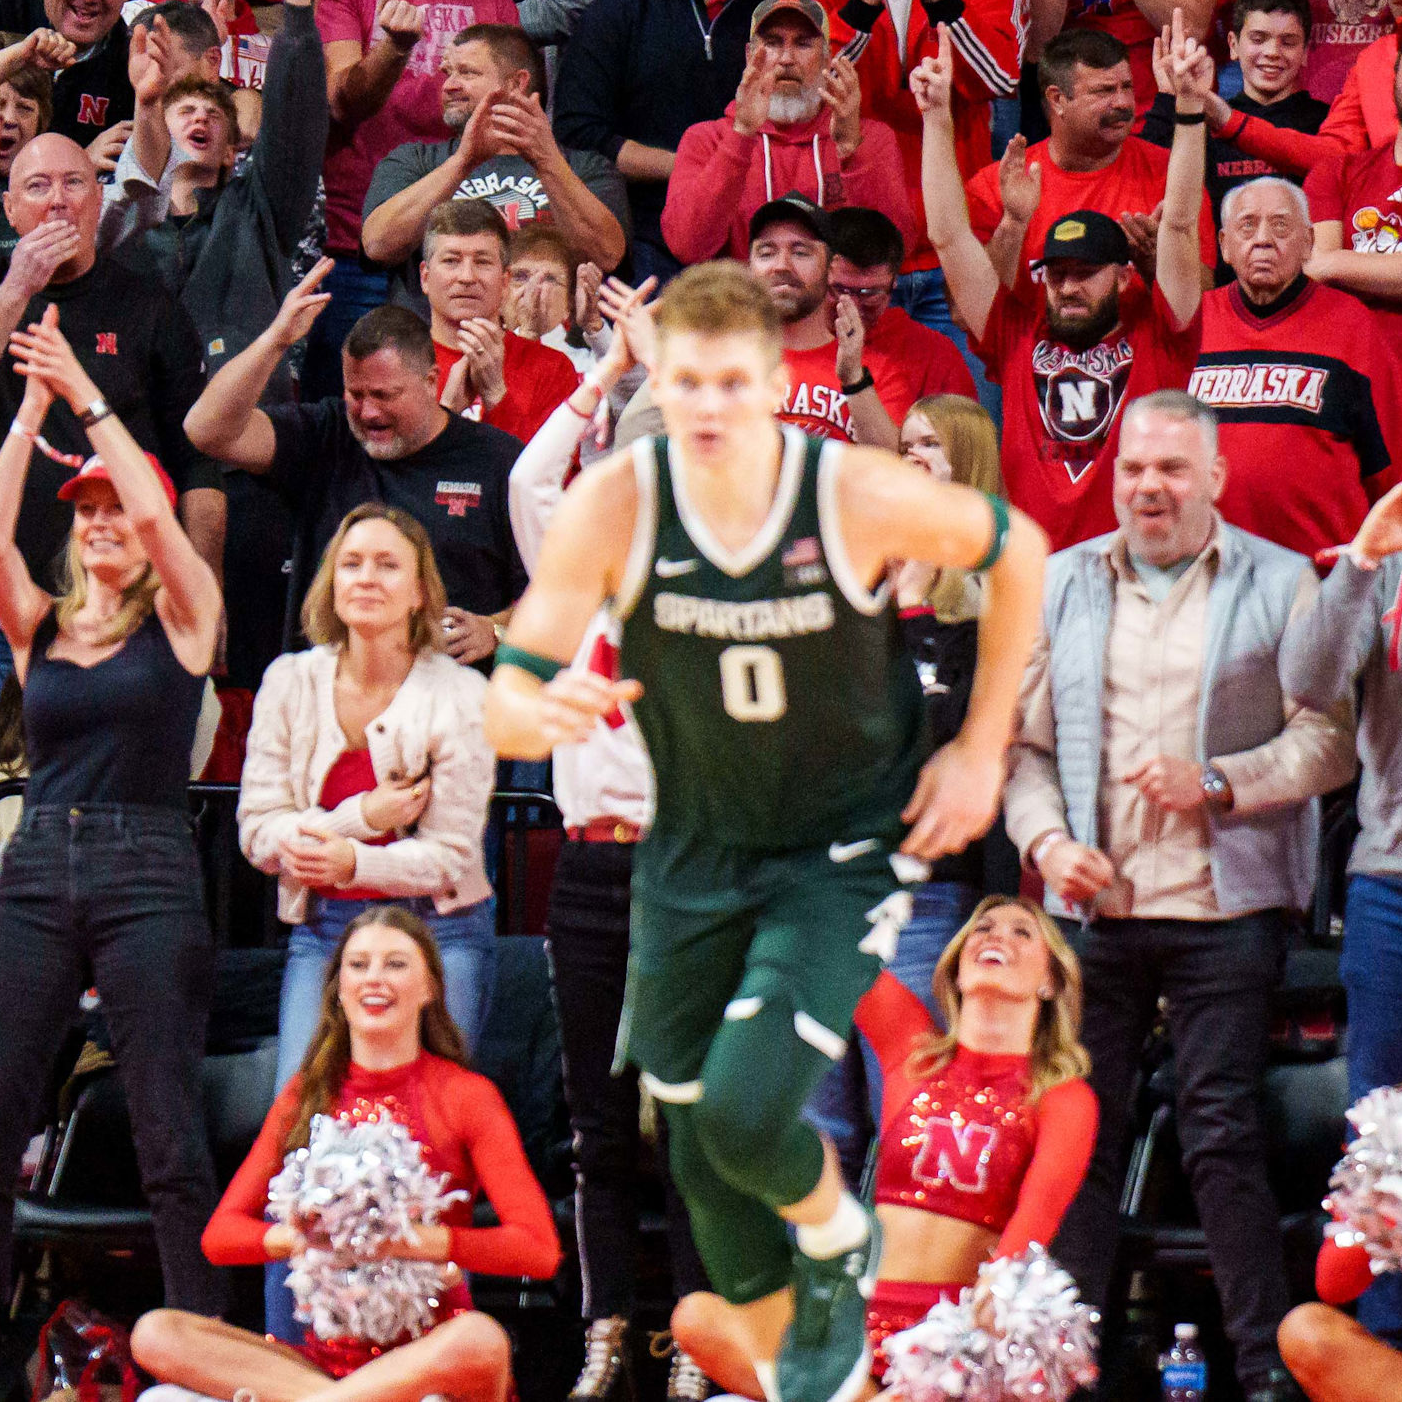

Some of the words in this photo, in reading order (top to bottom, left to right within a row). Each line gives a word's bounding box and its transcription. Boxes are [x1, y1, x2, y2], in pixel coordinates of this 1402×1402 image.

[77, 92, 111, 127] N
[94, 330, 118, 356] N
[1057, 381, 1097, 423] N
[653, 590, 836, 641] SPARTANS
[717, 644, 788, 724] 0
[910, 1114, 996, 1194] N
